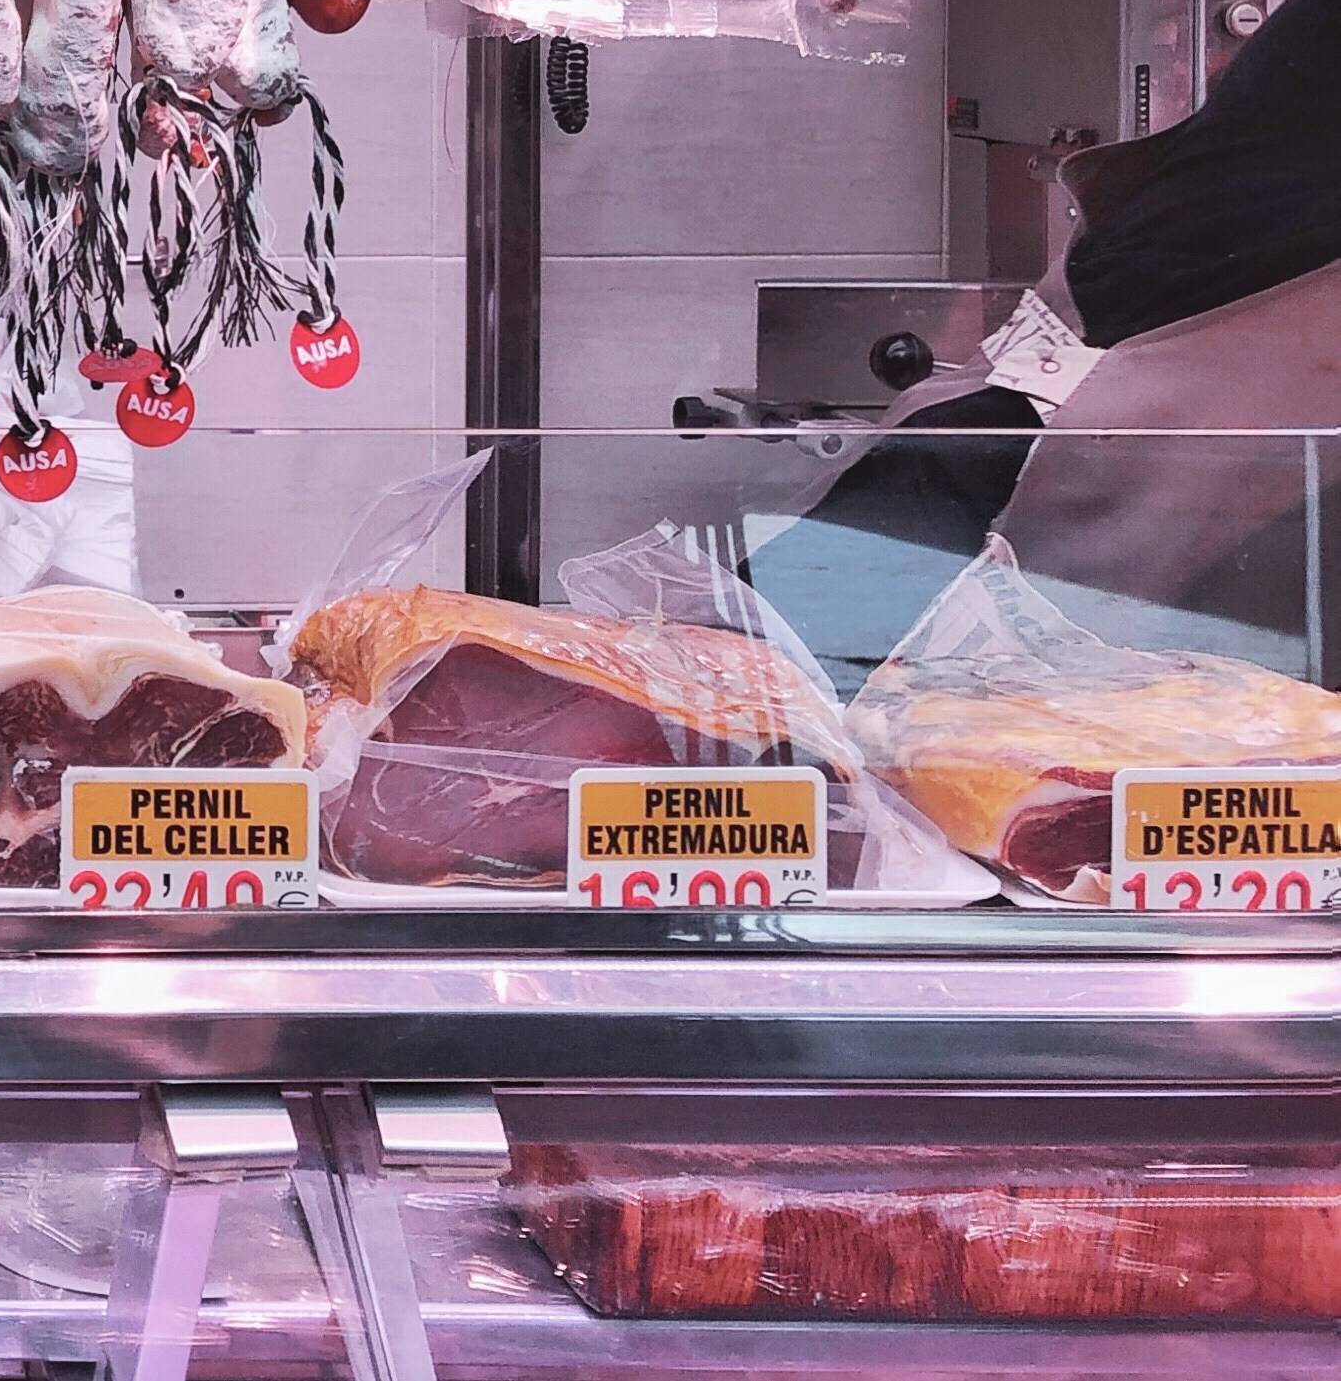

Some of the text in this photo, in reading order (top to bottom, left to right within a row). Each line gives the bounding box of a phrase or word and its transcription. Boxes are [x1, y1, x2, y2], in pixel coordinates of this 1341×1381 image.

[297, 333, 353, 366] AUSA
[125, 392, 191, 426] AUSA
[2, 448, 69, 476] AUSA
[129, 788, 252, 820] PERNIL
[644, 787, 752, 819] PERNIL
[1182, 787, 1302, 819] PERNIL
[91, 824, 290, 856] DEL CELLER
[586, 823, 810, 856] EXTREMADURA
[1142, 823, 1338, 855] D'ESPATLLA
[274, 870, 308, 883] P.V.P.
[782, 869, 816, 882] P.V.P.
